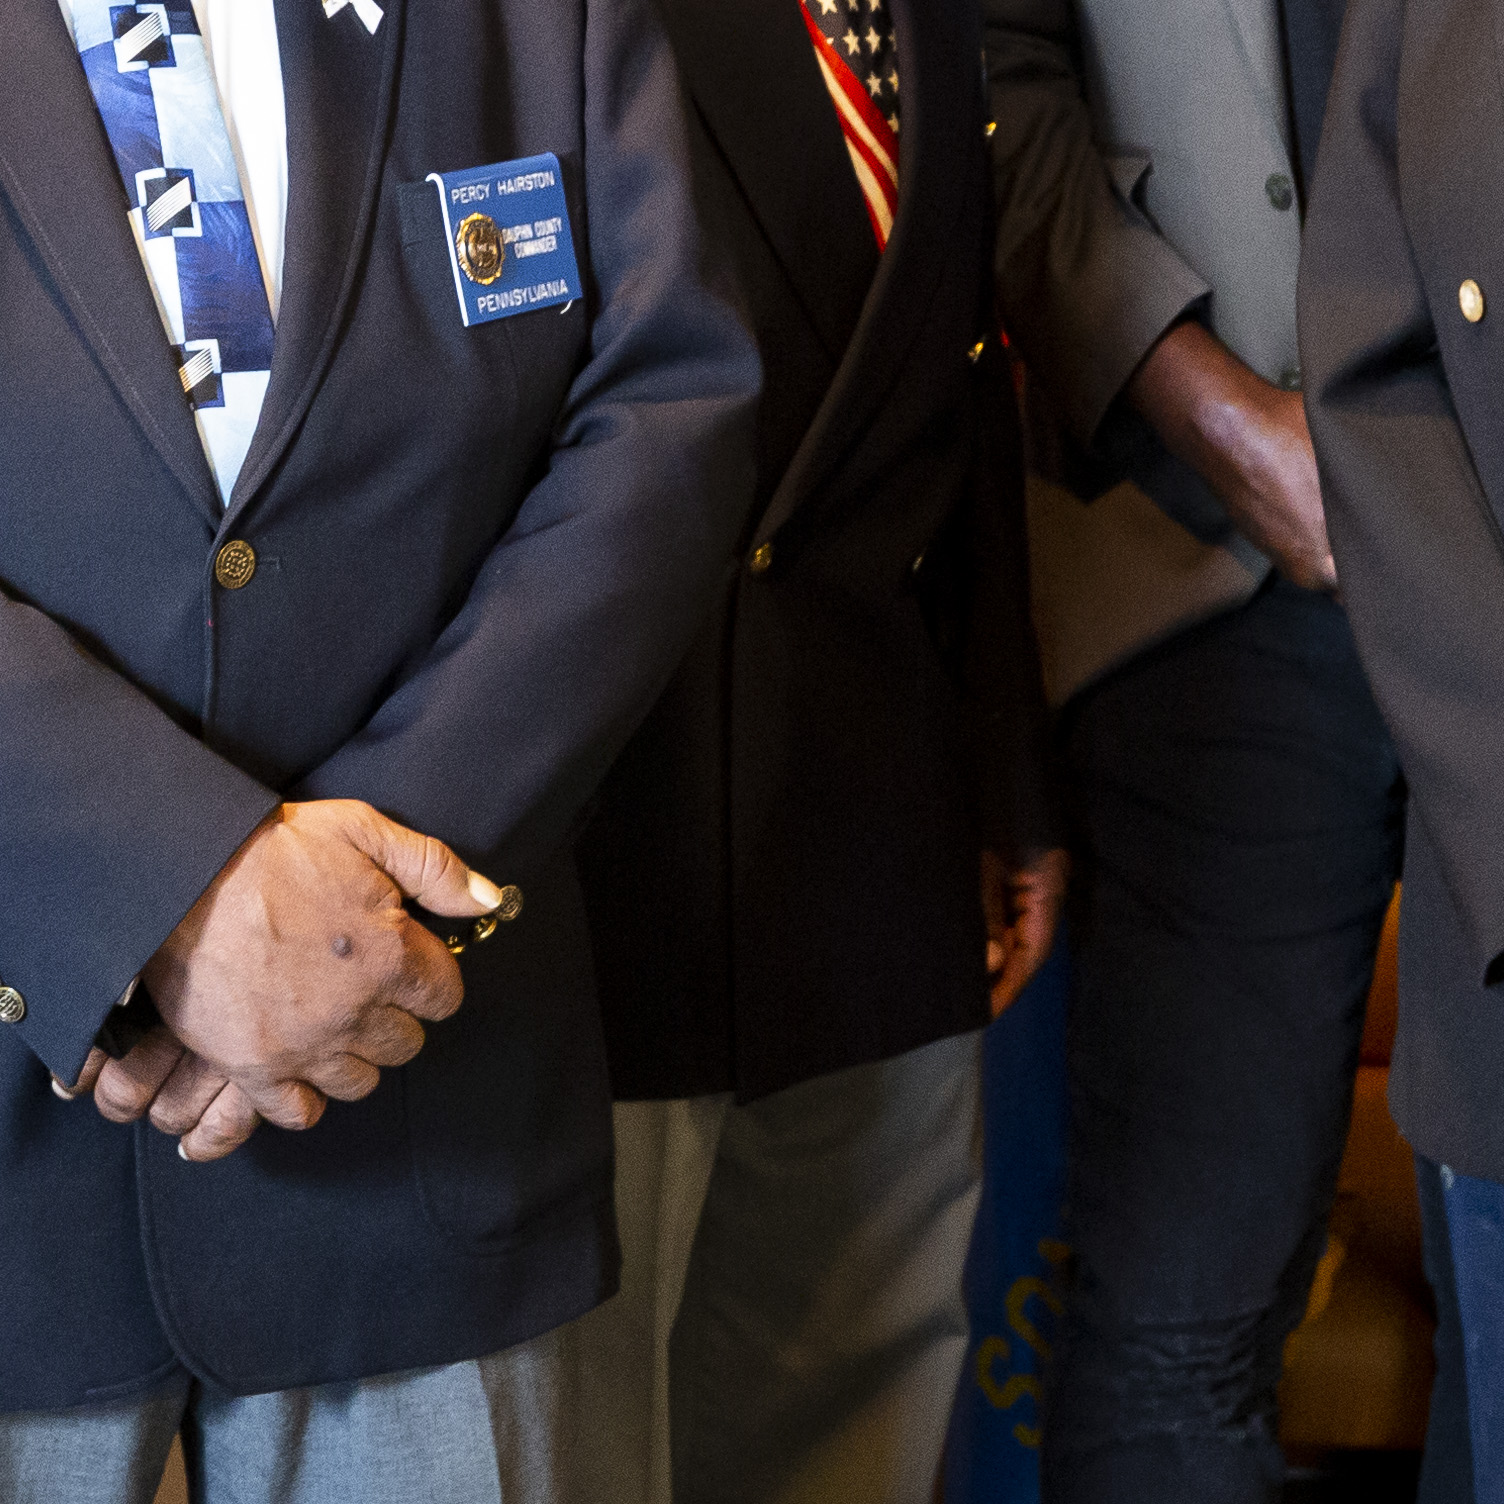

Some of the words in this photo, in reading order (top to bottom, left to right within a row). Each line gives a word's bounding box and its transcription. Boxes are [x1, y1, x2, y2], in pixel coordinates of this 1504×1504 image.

[451, 183, 490, 206] PERCY
[497, 170, 556, 196] HAIRSTON
[477, 279, 569, 315] PENNSYLVANIA
